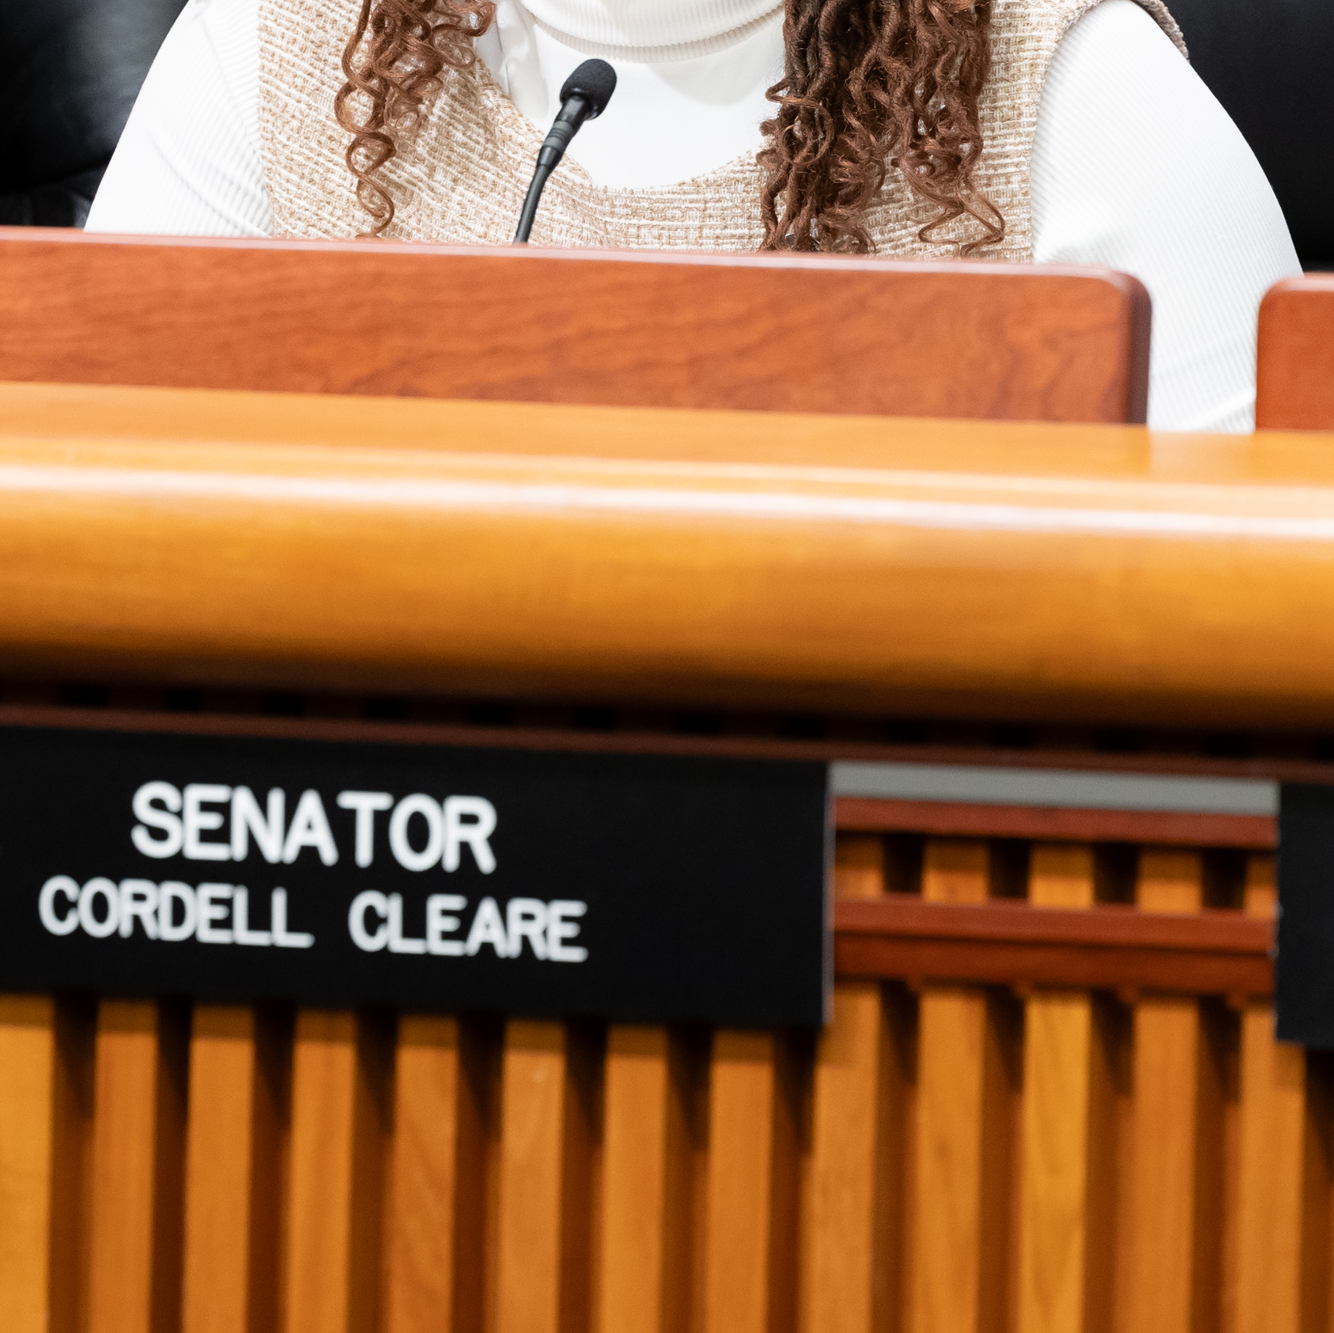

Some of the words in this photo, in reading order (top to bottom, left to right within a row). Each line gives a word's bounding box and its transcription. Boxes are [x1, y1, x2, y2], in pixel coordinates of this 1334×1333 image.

[131, 781, 497, 874] SENATOR
[38, 875, 315, 949] CORDELL
[348, 890, 588, 963] CLEARE
